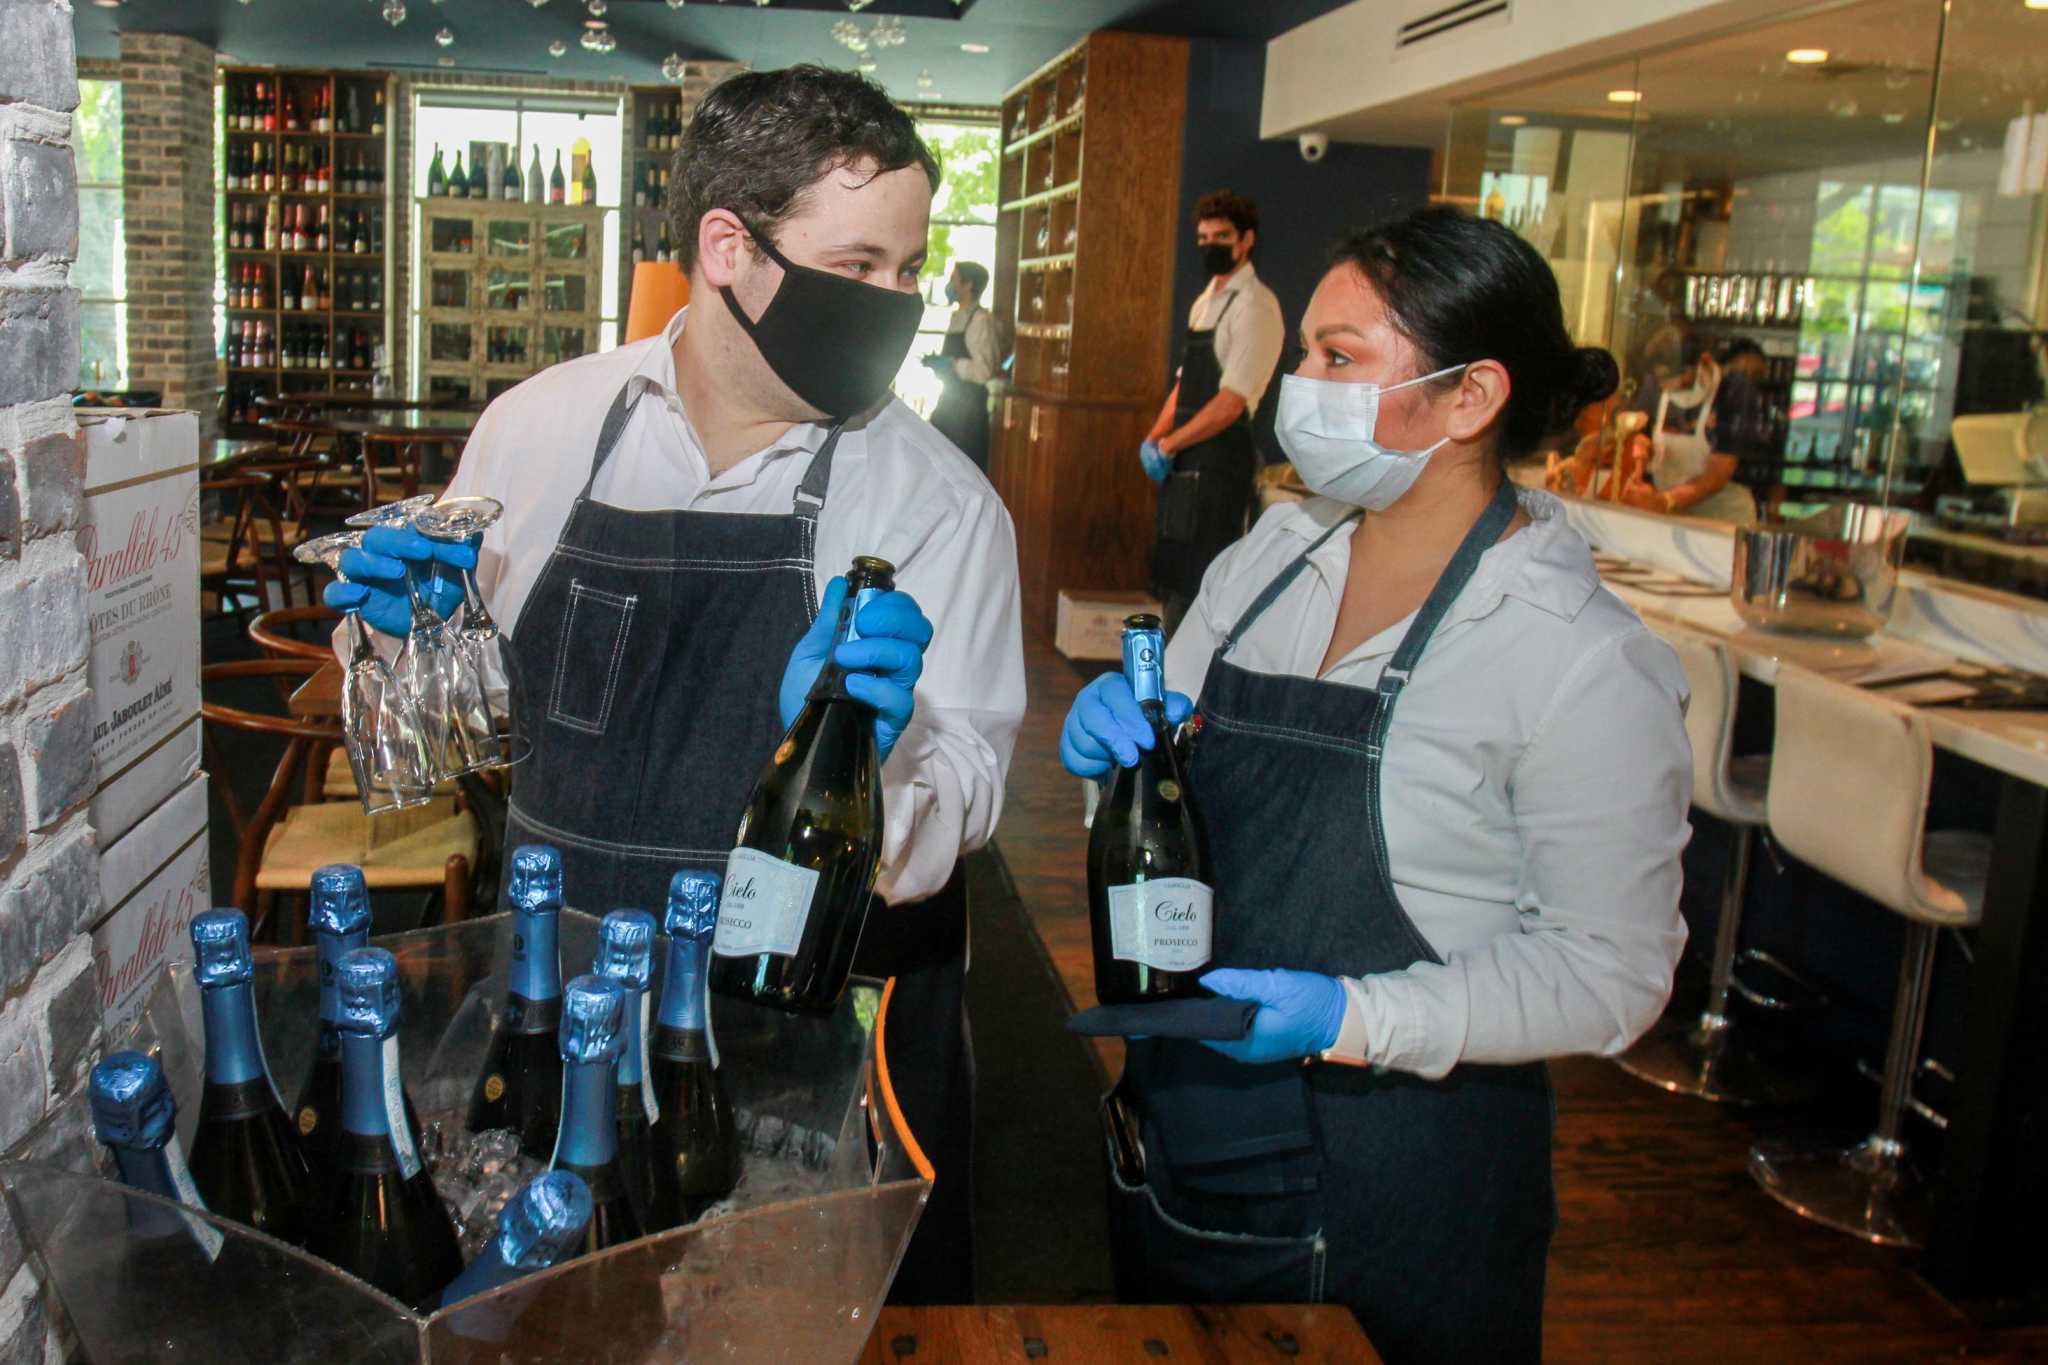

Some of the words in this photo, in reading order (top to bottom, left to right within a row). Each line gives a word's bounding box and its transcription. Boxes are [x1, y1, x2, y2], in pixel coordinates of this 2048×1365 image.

[161, 512, 183, 562] 45
[88, 605, 119, 634] ÔTES
[120, 599, 137, 621] DU
[93, 720, 110, 742] AUL
[725, 872, 757, 901] Cielo
[1155, 900, 1197, 921] Cielo
[1154, 937, 1199, 947] PROSECCO
